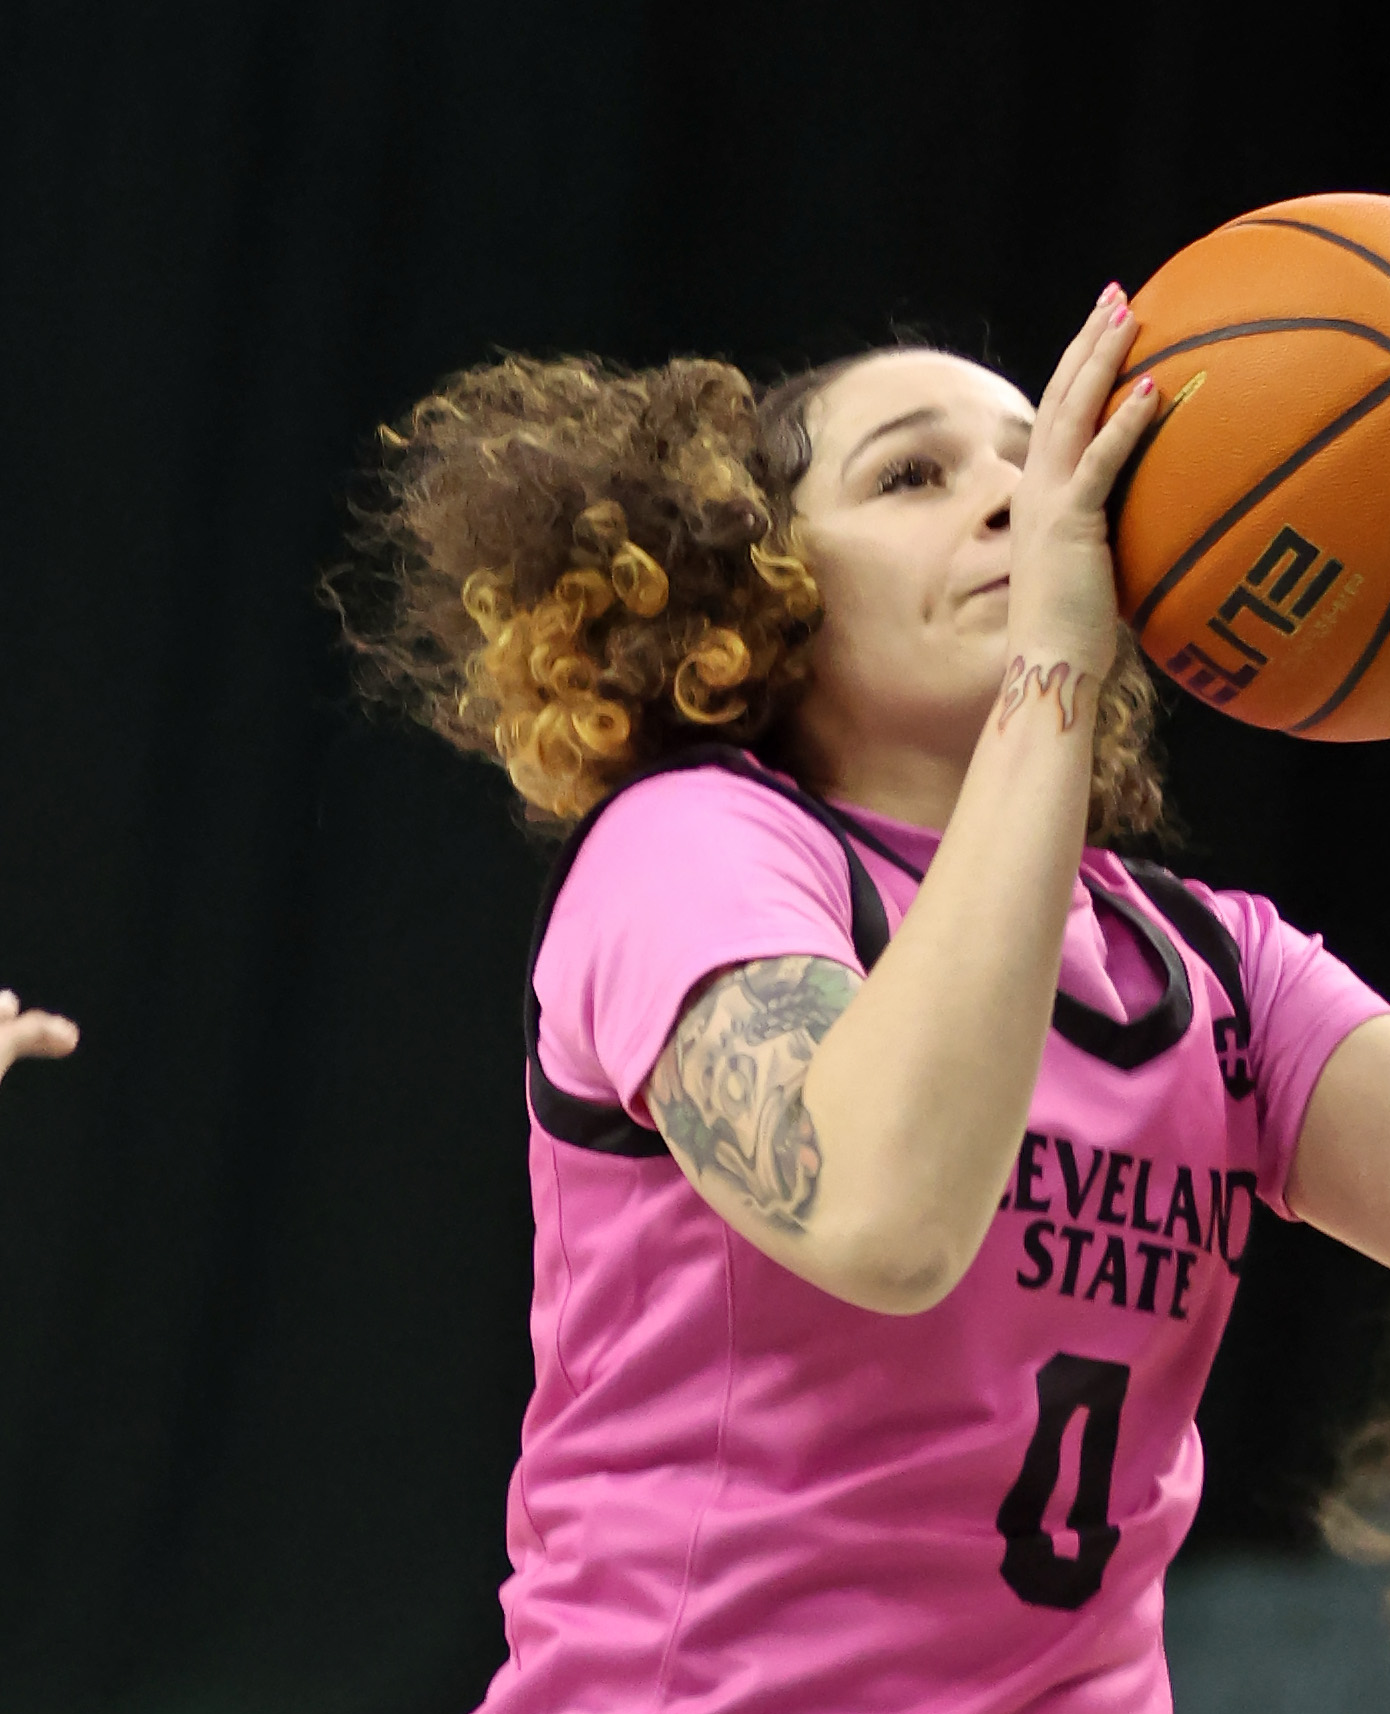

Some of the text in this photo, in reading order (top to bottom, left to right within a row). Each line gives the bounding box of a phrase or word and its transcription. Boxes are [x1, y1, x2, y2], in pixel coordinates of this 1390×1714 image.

[1166, 523, 1344, 705] ELITE
[998, 1130, 1258, 1276] EVELAND
[1016, 1219, 1198, 1320] STATE
[995, 1350, 1131, 1610] 0
